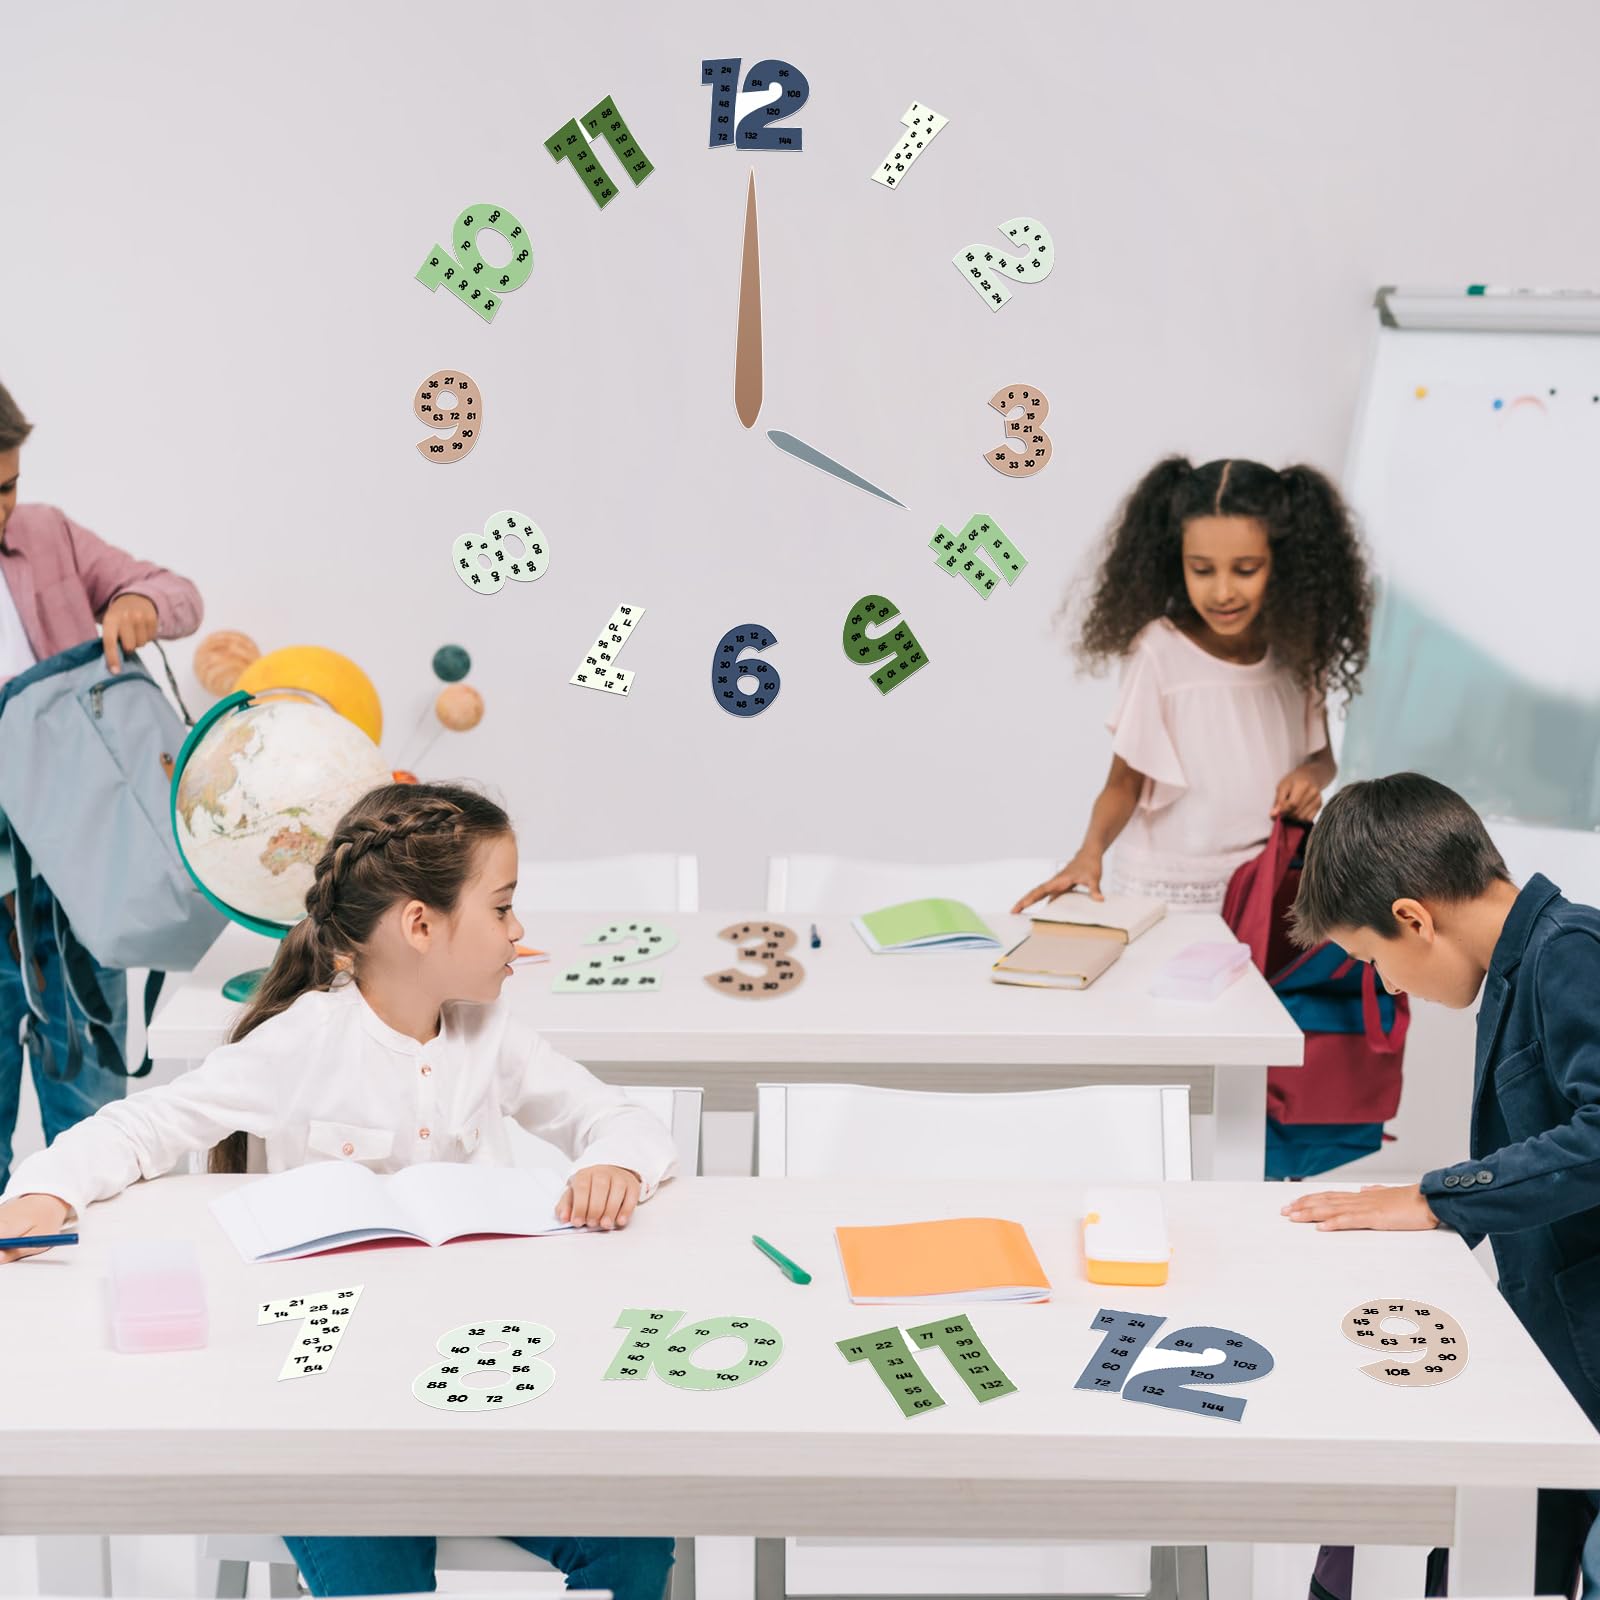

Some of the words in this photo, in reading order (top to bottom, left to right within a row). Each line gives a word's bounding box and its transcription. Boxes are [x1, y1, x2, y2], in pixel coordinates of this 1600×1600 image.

[704, 68, 713, 76] 12
[721, 66, 732, 74] 24
[751, 79, 762, 87] 84
[787, 90, 801, 98] 108
[701, 58, 809, 151] 12
[601, 108, 613, 119] 88
[766, 108, 780, 116] 120
[589, 119, 597, 129] 77
[718, 116, 729, 124] 60
[913, 118, 920, 126] 2
[610, 121, 621, 131] 99
[566, 135, 578, 145] 22
[615, 133, 628, 145] 110
[718, 133, 728, 141] 72
[744, 132, 758, 140] 132
[554, 144, 562, 153] 11
[871, 100, 949, 190] 1
[543, 94, 655, 210] 11
[577, 150, 587, 160] 33
[623, 147, 636, 158] 121
[894, 152, 901, 160] 9
[905, 152, 913, 160] 8
[632, 161, 646, 172] 132
[884, 163, 892, 172] 11
[895, 163, 905, 172] 10
[886, 176, 895, 186] 12
[463, 215, 474, 226] 60
[488, 210, 501, 223] 120
[510, 226, 522, 238] 110
[1009, 229, 1017, 237] 2
[461, 240, 471, 251] 70
[1038, 245, 1046, 253] 8
[516, 249, 529, 263] 100
[965, 252, 975, 262] 18
[984, 252, 993, 262] 16
[414, 203, 534, 323] 10
[430, 257, 439, 267] 10
[952, 216, 1054, 313] 2
[1031, 258, 1041, 268] 10
[473, 262, 483, 274] 80
[970, 267, 982, 278] 20
[1016, 264, 1025, 274] 12
[444, 268, 455, 280] 20
[499, 275, 510, 286] 90
[458, 280, 468, 291] 30
[980, 280, 991, 291] 22
[991, 293, 1002, 304] 24
[428, 380, 439, 388] 36
[444, 377, 454, 385] 27
[459, 382, 468, 390] 18
[1008, 391, 1014, 399] 6
[1023, 391, 1029, 399] 9
[467, 397, 473, 405] 9
[1000, 400, 1006, 408] 3
[1031, 398, 1040, 406] 12
[413, 369, 483, 464] 9
[433, 413, 444, 421] 63
[450, 412, 460, 420] 72
[466, 412, 476, 420] 81
[1026, 412, 1035, 420] 15
[983, 383, 1053, 477] 3
[1011, 422, 1020, 431] 18
[1023, 425, 1032, 433] 21
[462, 429, 473, 438] 90
[1032, 435, 1043, 443] 24
[430, 445, 444, 453] 108
[452, 442, 463, 450] 99
[1035, 448, 1045, 456] 27
[995, 453, 1006, 461] 36
[1009, 461, 1019, 469] 33
[1024, 459, 1035, 468] 30
[968, 529, 979, 541] 20
[993, 539, 1002, 548] 12
[452, 510, 550, 595] 8
[928, 513, 1029, 600] 4
[611, 634, 622, 643] 63
[750, 632, 759, 640] 12
[569, 602, 646, 696] 7
[843, 594, 930, 696] 5
[720, 661, 731, 669] 30
[738, 665, 748, 673] 72
[595, 667, 607, 676] 28
[712, 623, 781, 718] 6
[604, 680, 614, 689] 21
[764, 682, 775, 690] 60
[551, 919, 680, 994] 2
[704, 921, 805, 1001] 3
[263, 1304, 270, 1312] 7
[310, 1317, 328, 1326] 49
[1100, 1316, 1114, 1324] 12
[1353, 1318, 1370, 1326] 45
[257, 1285, 364, 1381] 7
[468, 1328, 486, 1336] 32
[501, 1325, 520, 1333] 24
[945, 1325, 964, 1334] 88
[302, 1337, 320, 1346] 63
[754, 1338, 776, 1346] 120
[875, 1341, 893, 1350] 22
[956, 1338, 973, 1347] 99
[1340, 1297, 1469, 1388] 9
[1380, 1338, 1399, 1346] 63
[315, 1344, 333, 1353] 70
[450, 1346, 470, 1354] 40
[511, 1349, 522, 1357] 8
[601, 1307, 784, 1391] 10
[850, 1346, 863, 1354] 11
[294, 1355, 309, 1364] 77
[959, 1351, 981, 1360] 110
[1438, 1353, 1457, 1361] 90
[411, 1319, 556, 1412] 8
[477, 1358, 496, 1366] 48
[749, 1359, 768, 1367] 110
[835, 1313, 1020, 1419] 11
[1073, 1308, 1275, 1422] 12
[441, 1366, 459, 1374] 96
[968, 1365, 990, 1374] 121
[1384, 1368, 1411, 1376] 108
[1424, 1365, 1443, 1373] 99
[717, 1373, 739, 1382] 100
[1190, 1369, 1214, 1380] 120
[426, 1381, 447, 1389] 88
[515, 1383, 535, 1391] 64
[980, 1380, 1004, 1390] 132
[1094, 1378, 1111, 1387] 72
[1142, 1385, 1165, 1396] 132
[446, 1394, 468, 1403] 80
[486, 1395, 503, 1403] 72
